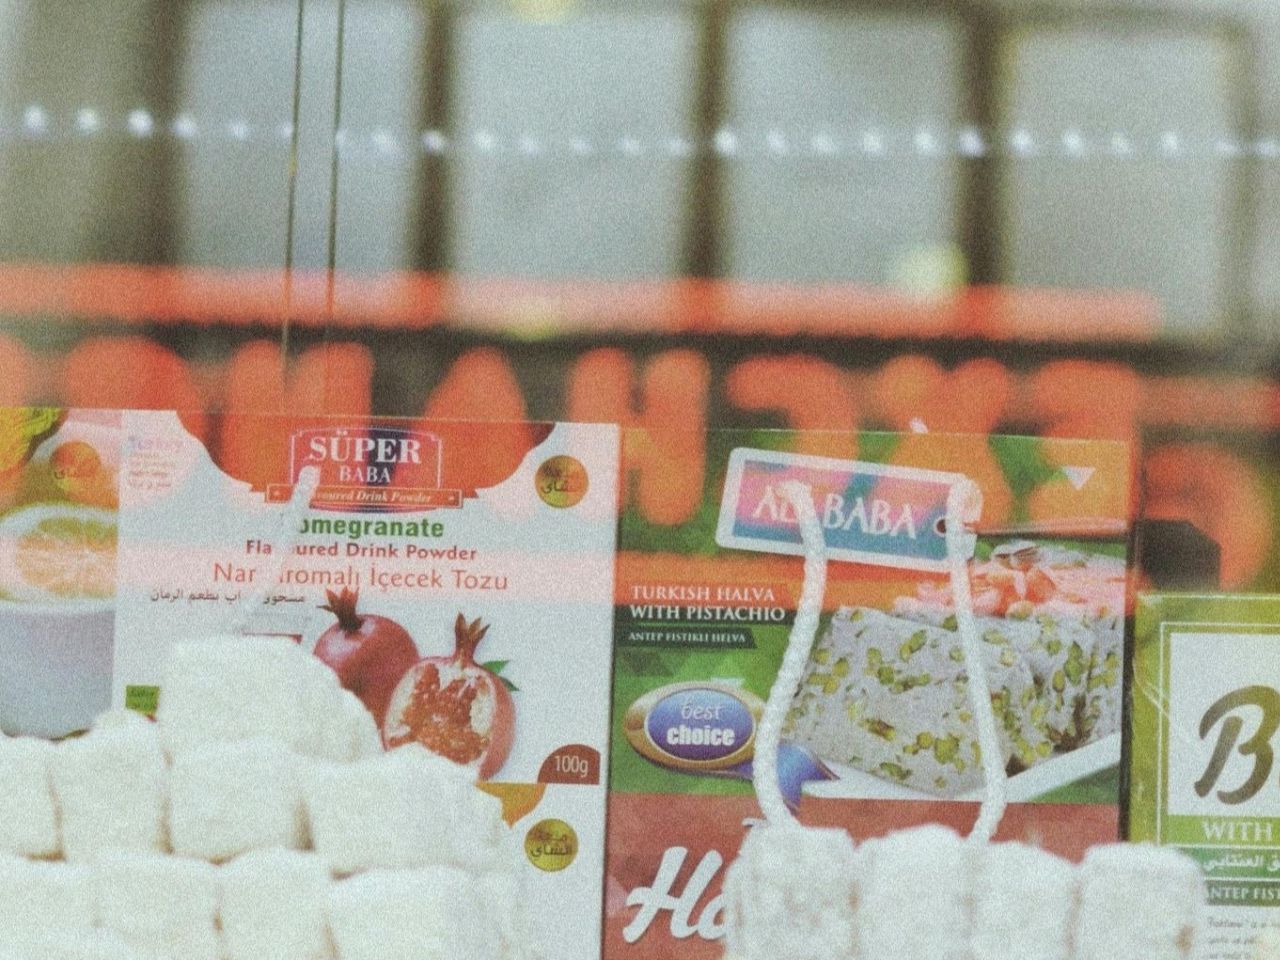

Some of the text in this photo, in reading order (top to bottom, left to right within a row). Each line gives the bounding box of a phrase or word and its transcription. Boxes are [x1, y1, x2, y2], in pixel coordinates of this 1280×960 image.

[308, 429, 421, 465] SÜPER
[339, 465, 392, 483] BABA
[823, 492, 917, 540] BABA
[300, 517, 444, 540] omegranate
[246, 539, 478, 561] Flaured Drink Powder
[213, 562, 510, 592] Nar romalı İçecek Tozu
[631, 584, 776, 602] TURKISH HALVA
[630, 604, 787, 622] WITH PISTACHIO
[681, 697, 724, 720] best
[666, 724, 735, 747] choice
[554, 753, 589, 778] 100g
[1203, 822, 1273, 841] WITH
